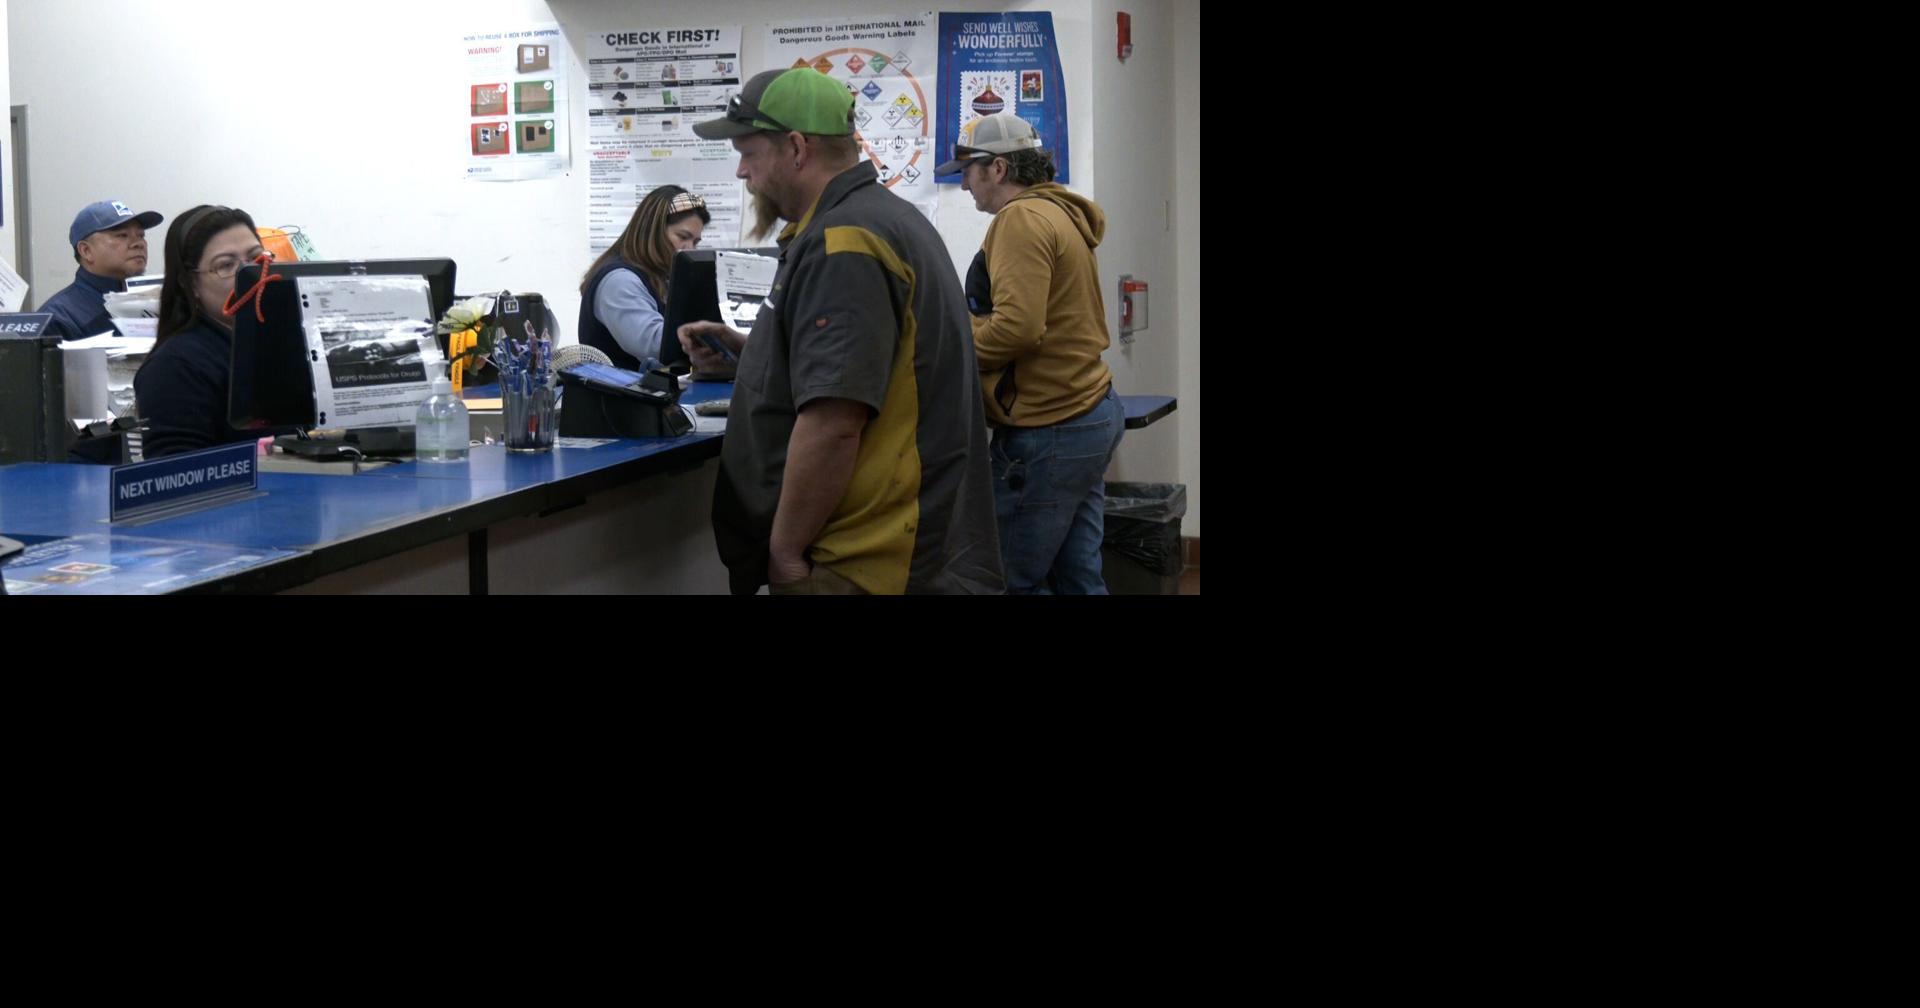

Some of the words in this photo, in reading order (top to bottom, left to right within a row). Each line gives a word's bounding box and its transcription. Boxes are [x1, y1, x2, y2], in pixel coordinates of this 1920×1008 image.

[772, 26, 823, 35] PROHIBITED
[835, 21, 901, 31] INTERNATIONAL
[962, 22, 987, 34] SEND
[989, 22, 1011, 33] WELL
[1013, 21, 1040, 32] WISHES
[605, 32, 661, 46] CHECK
[667, 29, 720, 43] FIRST!
[779, 36, 823, 44] Dangerous
[852, 32, 885, 40] Warning
[887, 30, 916, 38] Labels
[958, 33, 1044, 49] WONDERFULLY
[467, 46, 502, 55] WARNING!
[120, 479, 153, 500] NEXT
[154, 468, 205, 492] WINDOW
[207, 459, 250, 481] PLEASE
